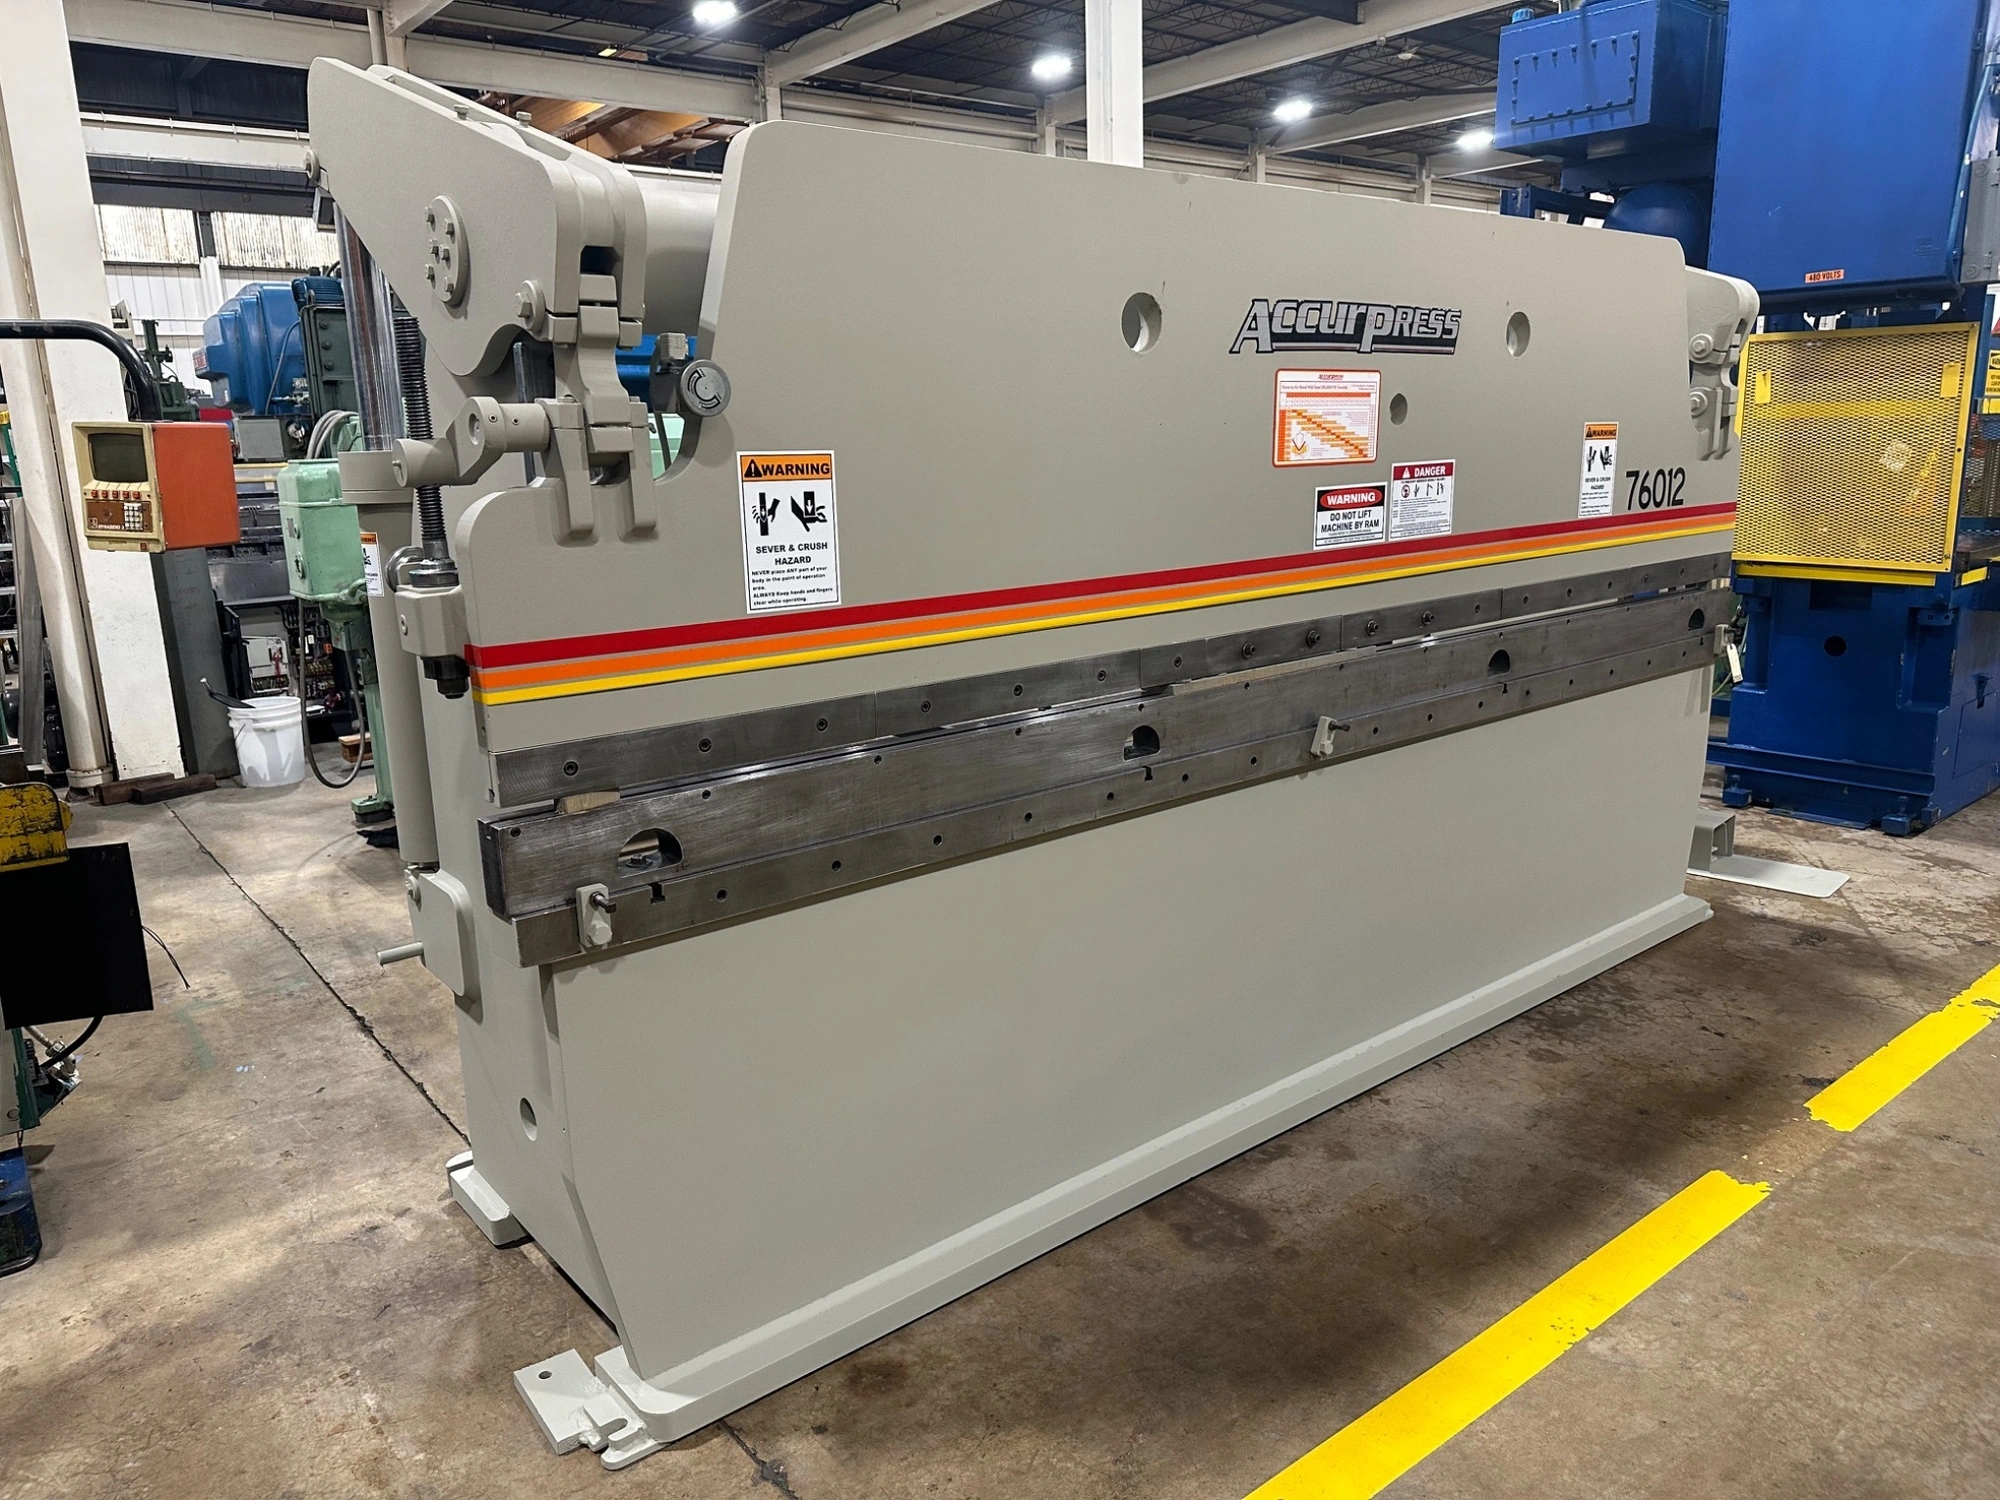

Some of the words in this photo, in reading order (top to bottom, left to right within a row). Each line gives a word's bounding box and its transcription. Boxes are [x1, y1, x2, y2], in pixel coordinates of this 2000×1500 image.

[1822, 270, 1841, 280] VOLTS
[1593, 429, 1616, 437] WARNING
[761, 462, 830, 476] WARNING
[1414, 465, 1446, 477] DANGER
[1625, 466, 1685, 510] 76012
[1327, 491, 1376, 506] WARNING
[1330, 512, 1340, 521] DO
[1342, 510, 1357, 520] NOT
[1358, 509, 1372, 519] LIFT
[1321, 521, 1353, 533] MACHINE
[1354, 520, 1363, 529] BY
[1364, 519, 1379, 528] RAM
[755, 544, 786, 554] SEVER
[788, 543, 795, 552] &
[797, 541, 828, 551] CRUSH
[774, 555, 812, 566] HAZARD
